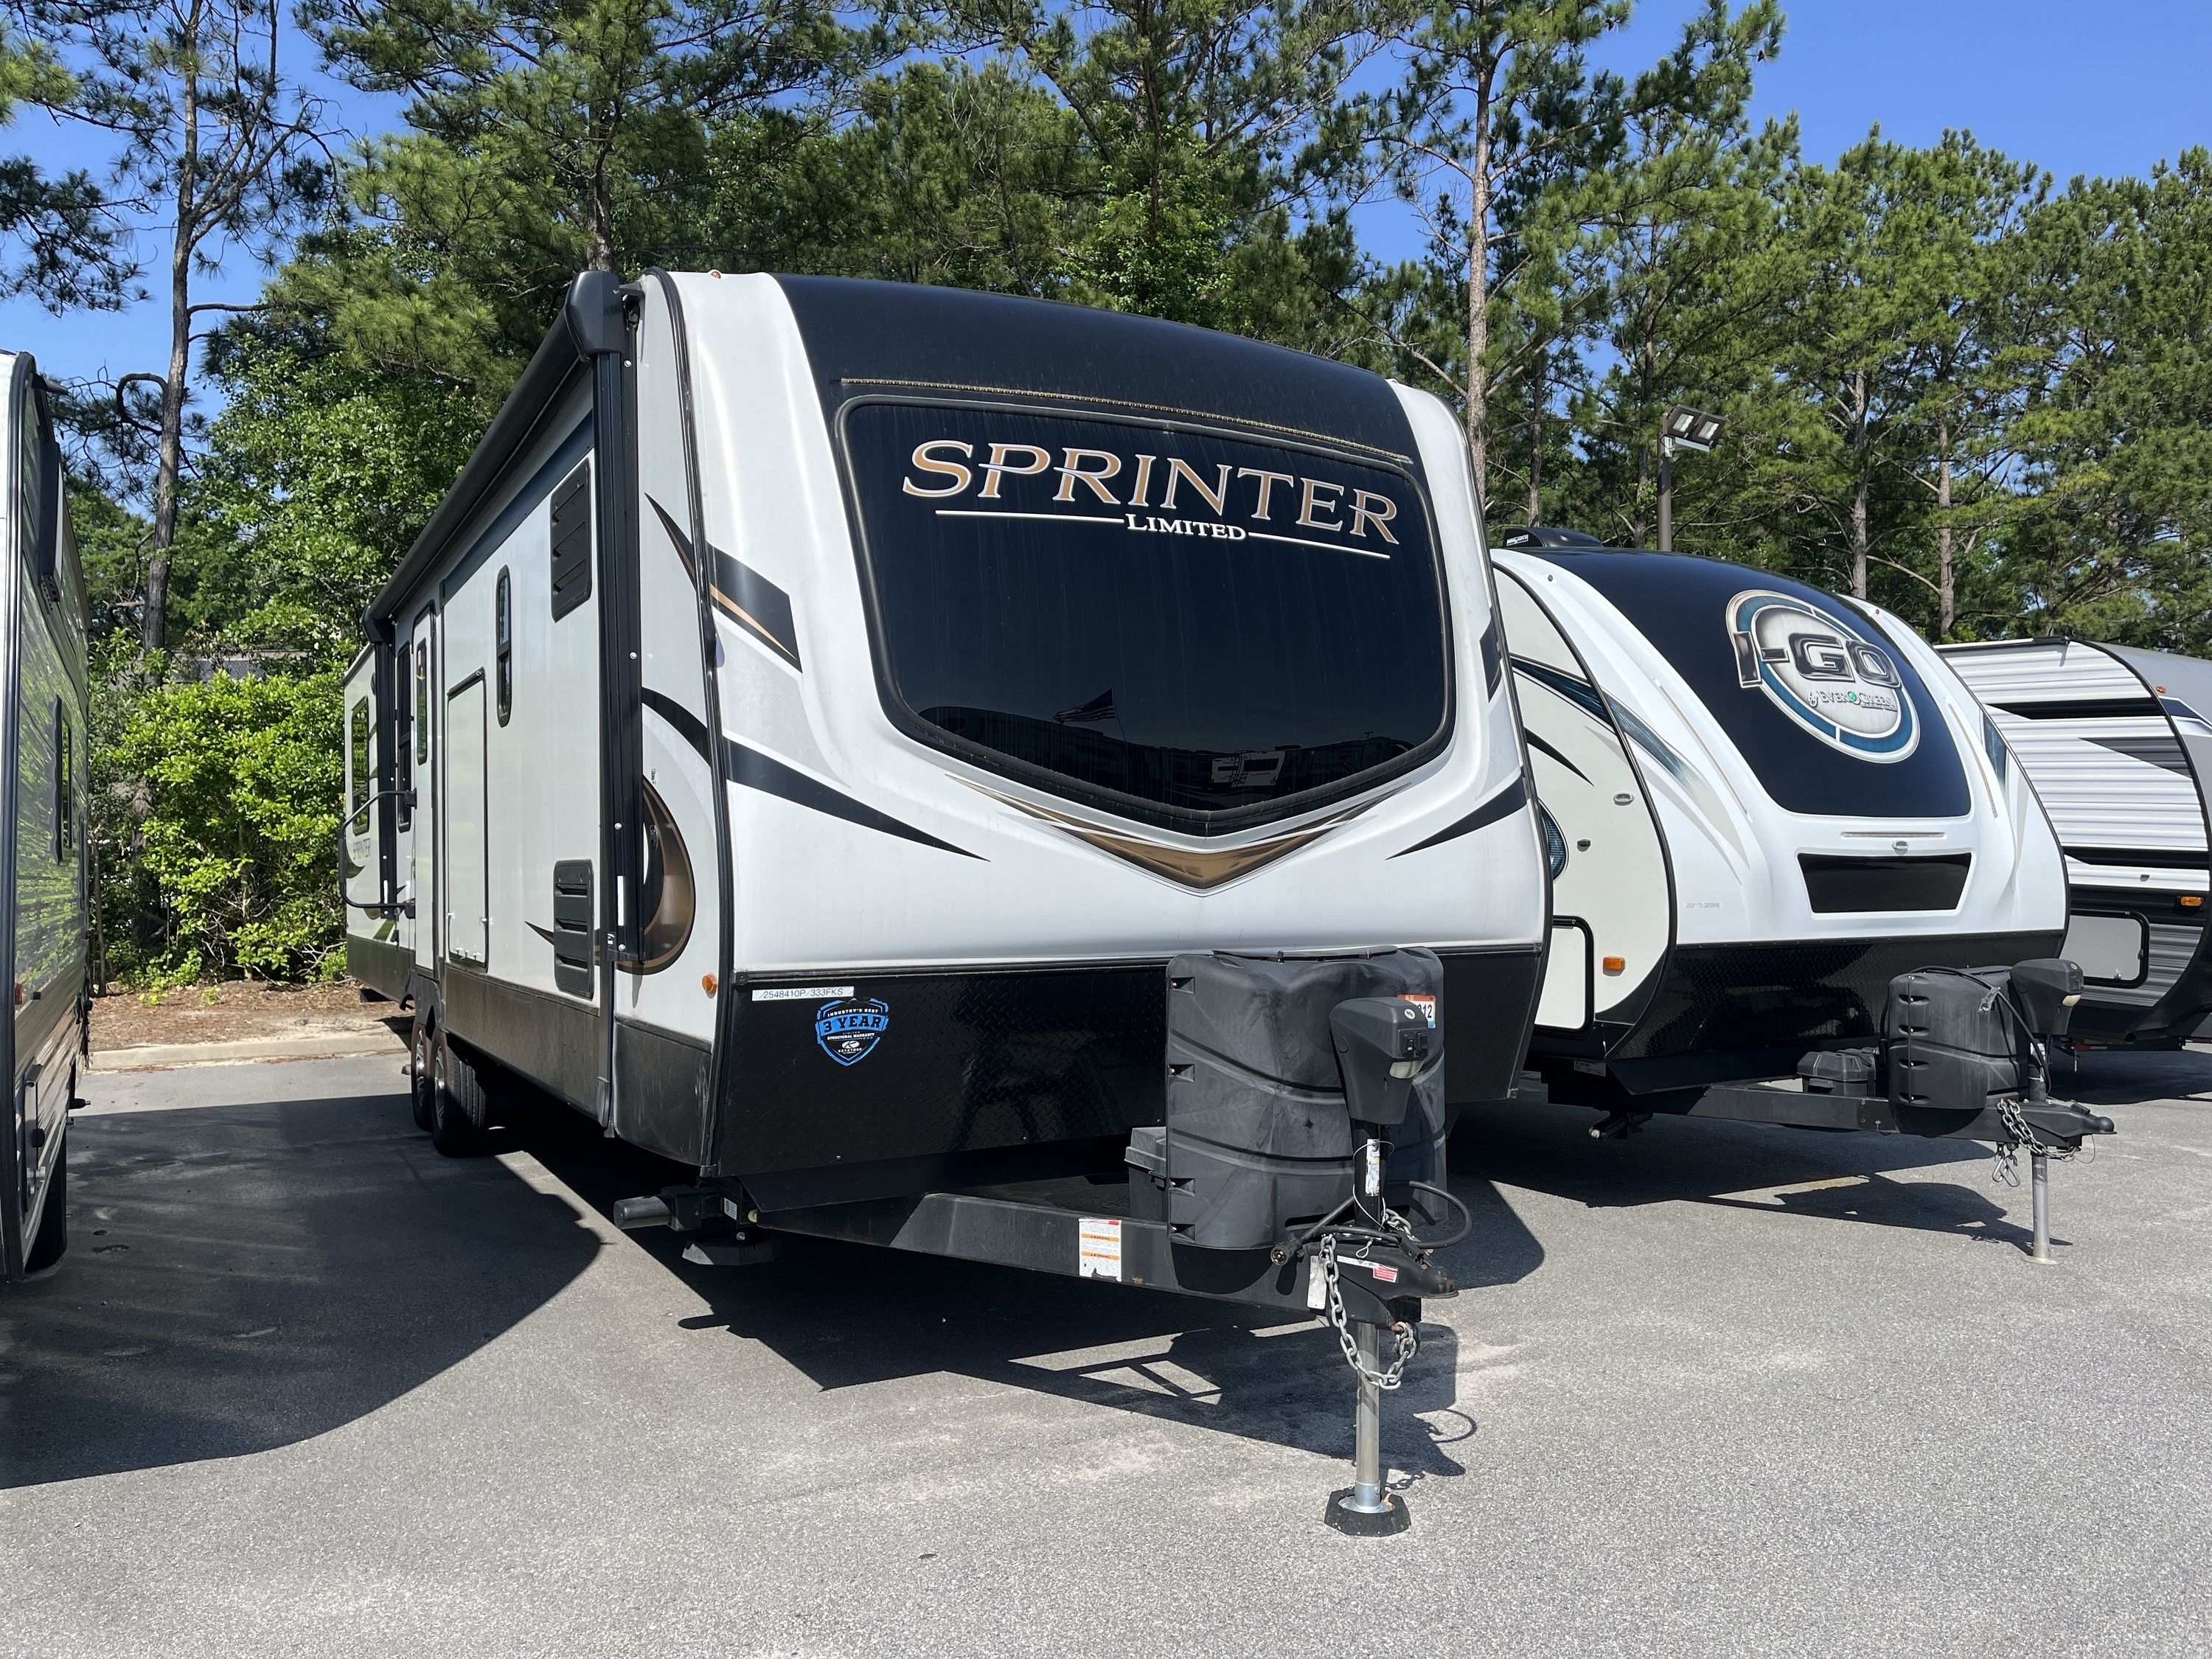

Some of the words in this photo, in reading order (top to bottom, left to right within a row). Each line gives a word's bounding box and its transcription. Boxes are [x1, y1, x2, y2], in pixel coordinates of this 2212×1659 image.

[902, 439, 1399, 545] SPRINTER
[1127, 514, 1246, 540] LIMITED
[1733, 630, 1904, 689] I-GO
[1808, 692, 1818, 707] by
[353, 838, 371, 860] SPRINTER
[763, 990, 806, 999] 2548410P
[810, 987, 844, 997] 333FKS
[827, 1008, 863, 1017] INDUSTRY'S
[823, 1020, 832, 1033] 3
[837, 1015, 882, 1029] YEAR
